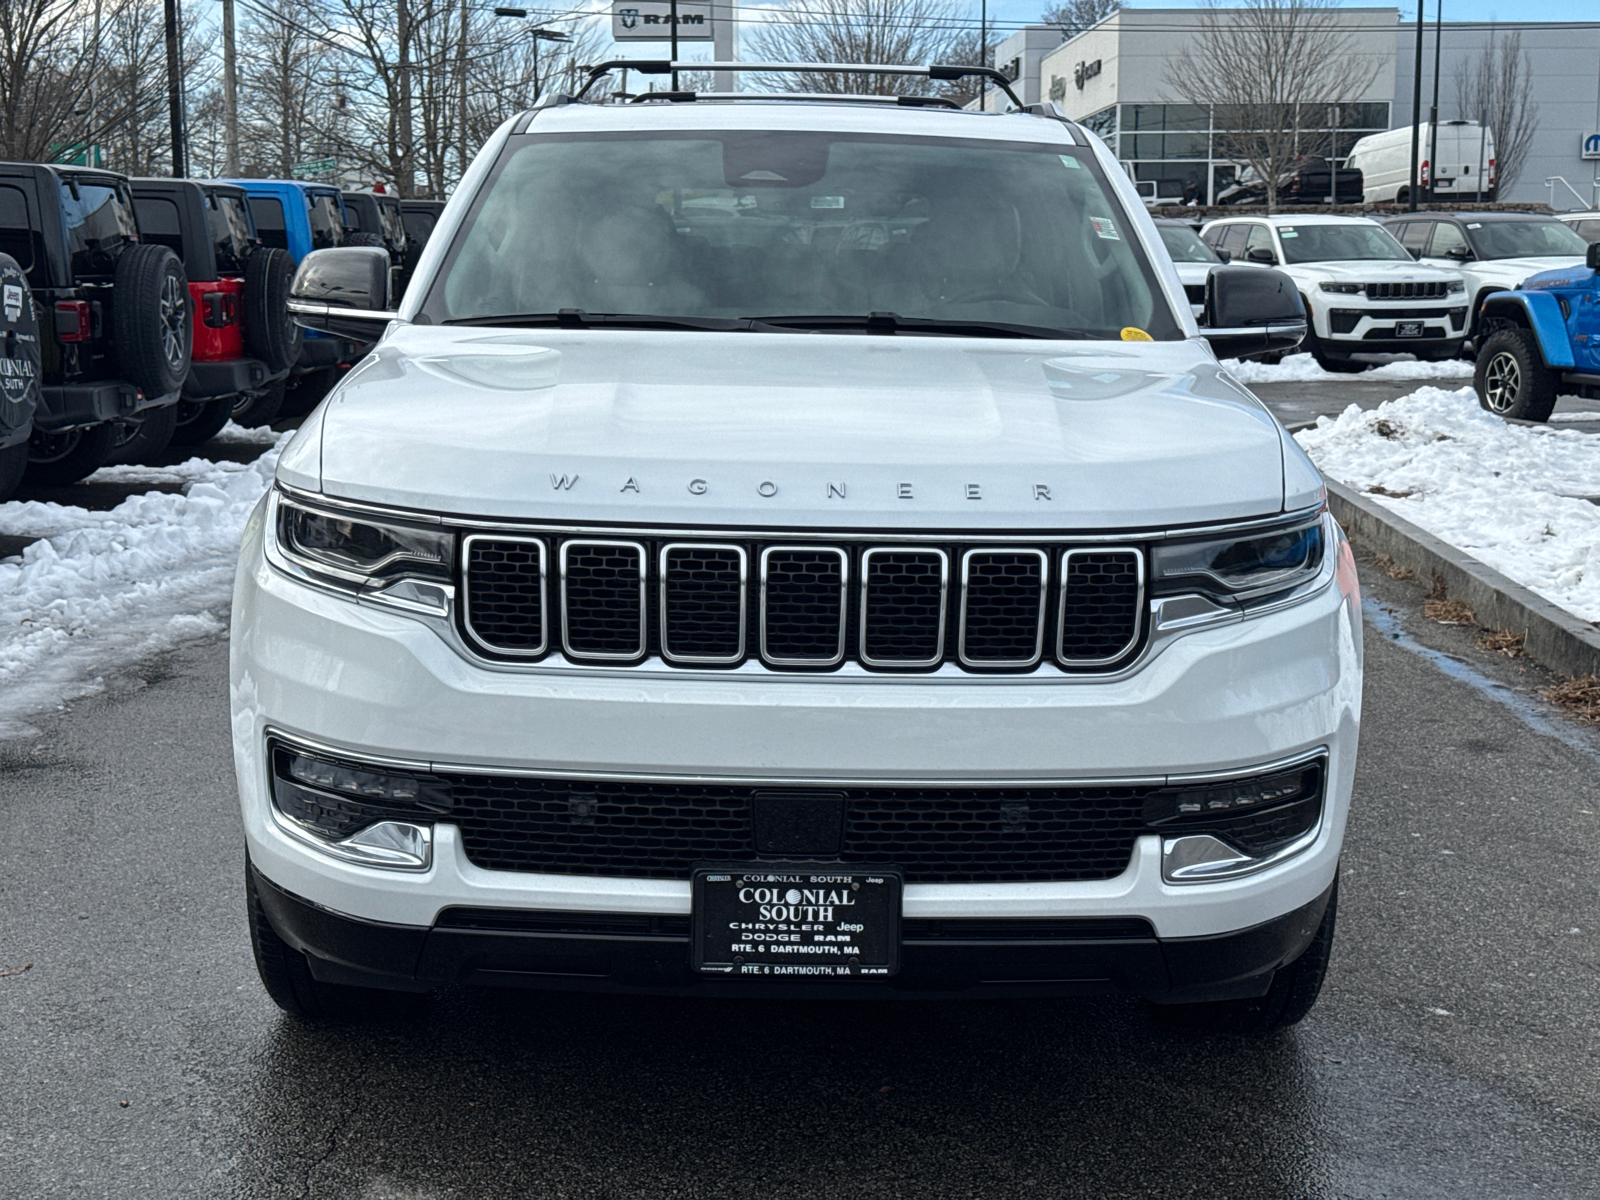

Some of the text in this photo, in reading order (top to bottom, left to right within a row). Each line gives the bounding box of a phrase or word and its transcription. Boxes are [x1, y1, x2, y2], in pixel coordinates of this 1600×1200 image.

[643, 14, 704, 24] RAM
[550, 473, 1052, 500] WAGONEER
[743, 875, 803, 883] COLONIAL
[739, 888, 855, 905] COLONIAL
[759, 905, 834, 922] SOUTH
[729, 922, 864, 933] CHRYSLER Jeep
[742, 933, 801, 941] DODGE
[731, 944, 860, 955] RTE. 6 DARTMOUTH, MA
[741, 966, 851, 976] RTE. 6 DARTMOUTH, MA
